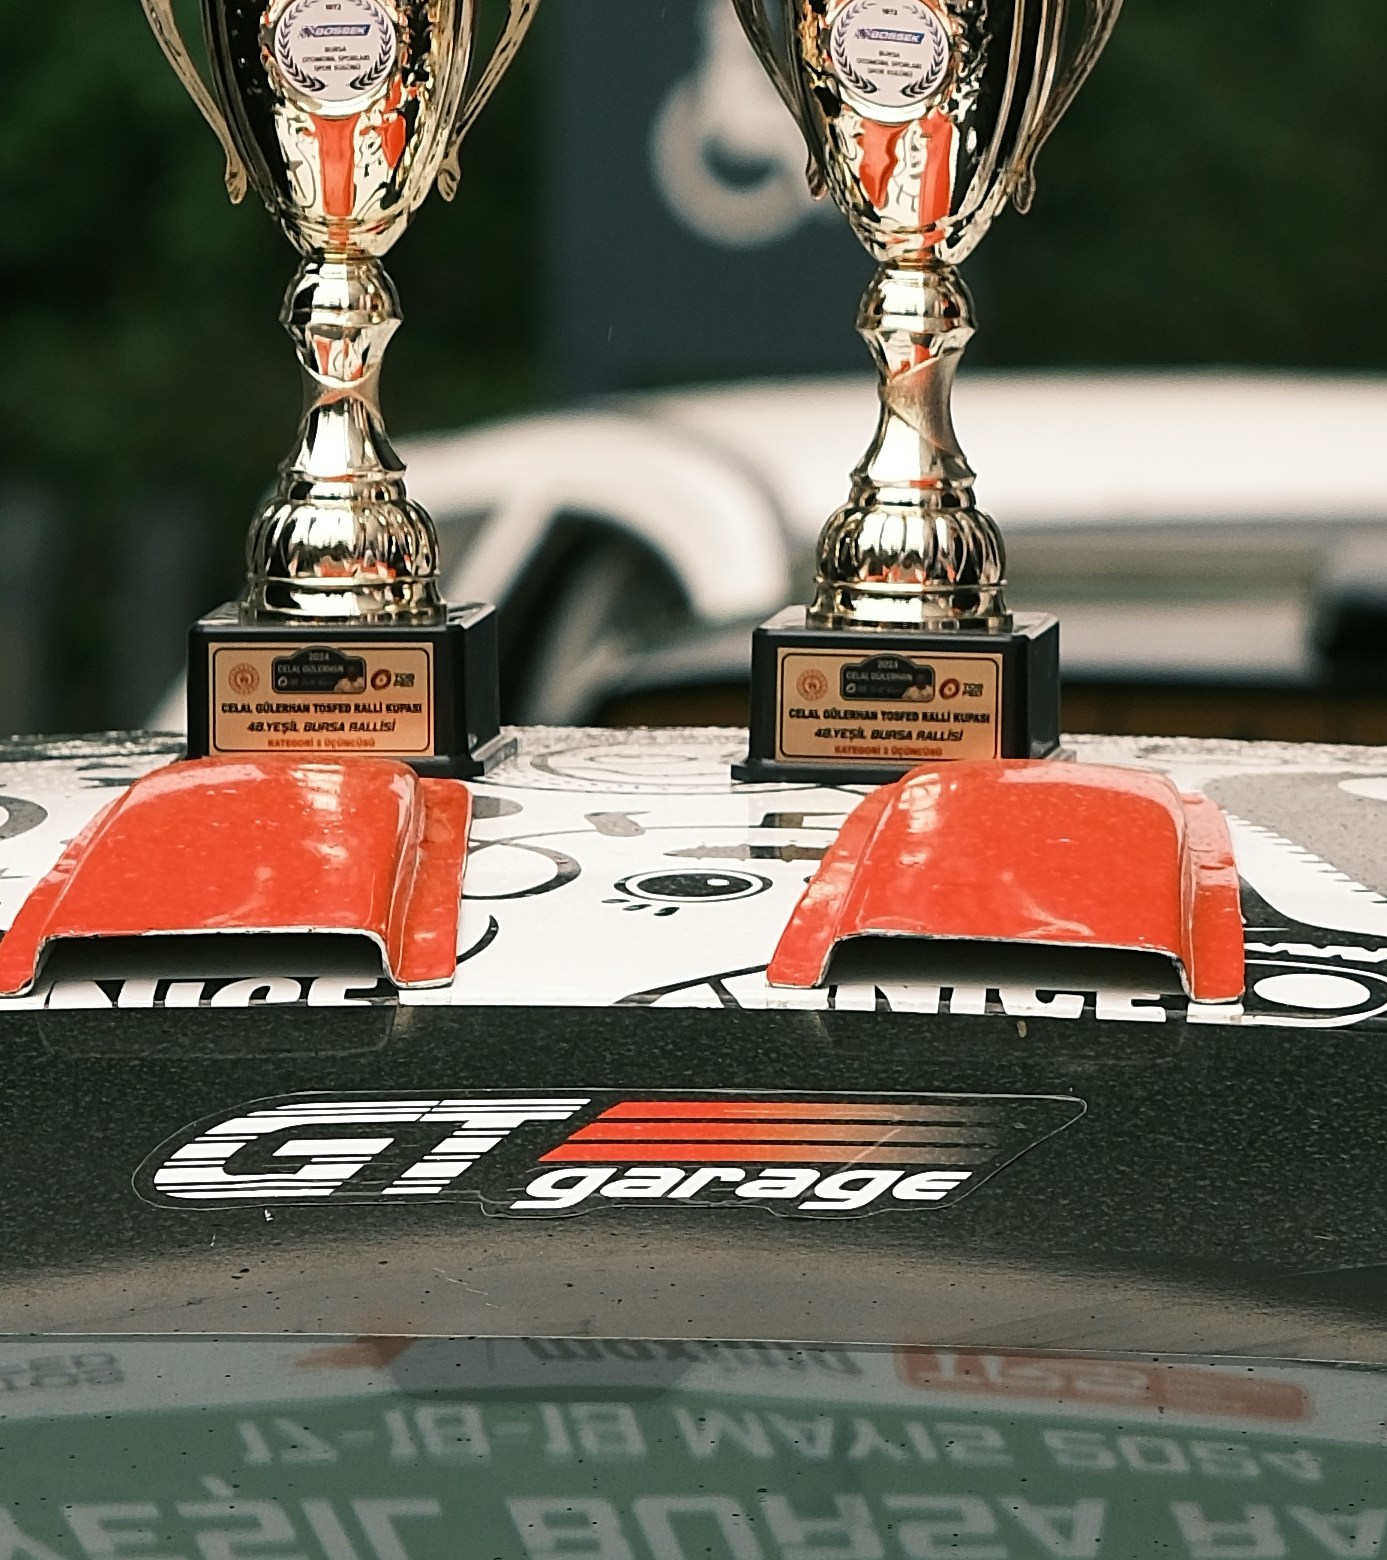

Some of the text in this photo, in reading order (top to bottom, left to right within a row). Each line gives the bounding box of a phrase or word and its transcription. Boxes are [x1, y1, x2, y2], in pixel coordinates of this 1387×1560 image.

[221, 703, 253, 714] CELAL
[256, 701, 310, 714] GÜLERHAN
[386, 703, 422, 713] KUPASI
[788, 708, 820, 719] CELAL
[823, 707, 878, 721] GÜLERHAN
[953, 712, 990, 724] KUPASI
[153, 1099, 591, 1199] GT
[511, 1167, 972, 1210] garage
